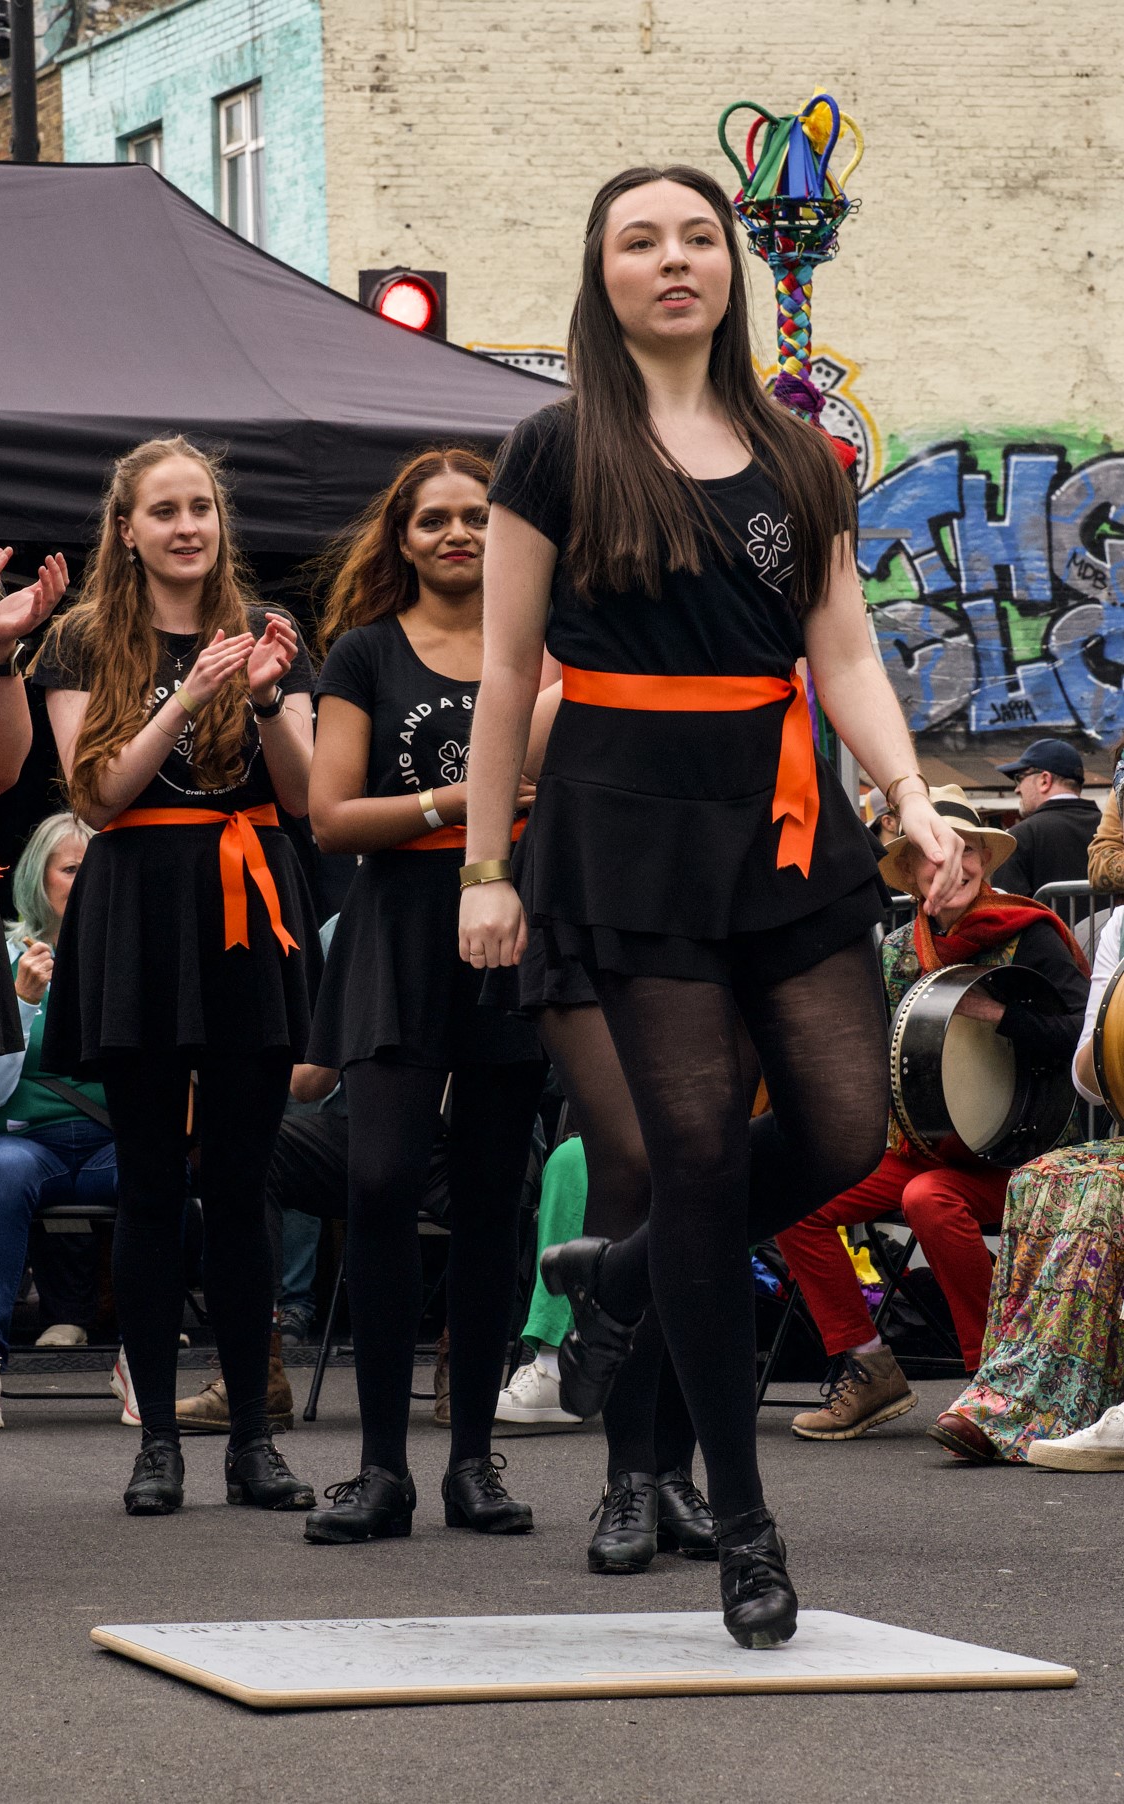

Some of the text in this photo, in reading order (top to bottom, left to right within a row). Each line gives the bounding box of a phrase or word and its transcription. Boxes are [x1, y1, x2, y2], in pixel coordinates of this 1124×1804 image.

[398, 695, 473, 786] JIG AND A S
